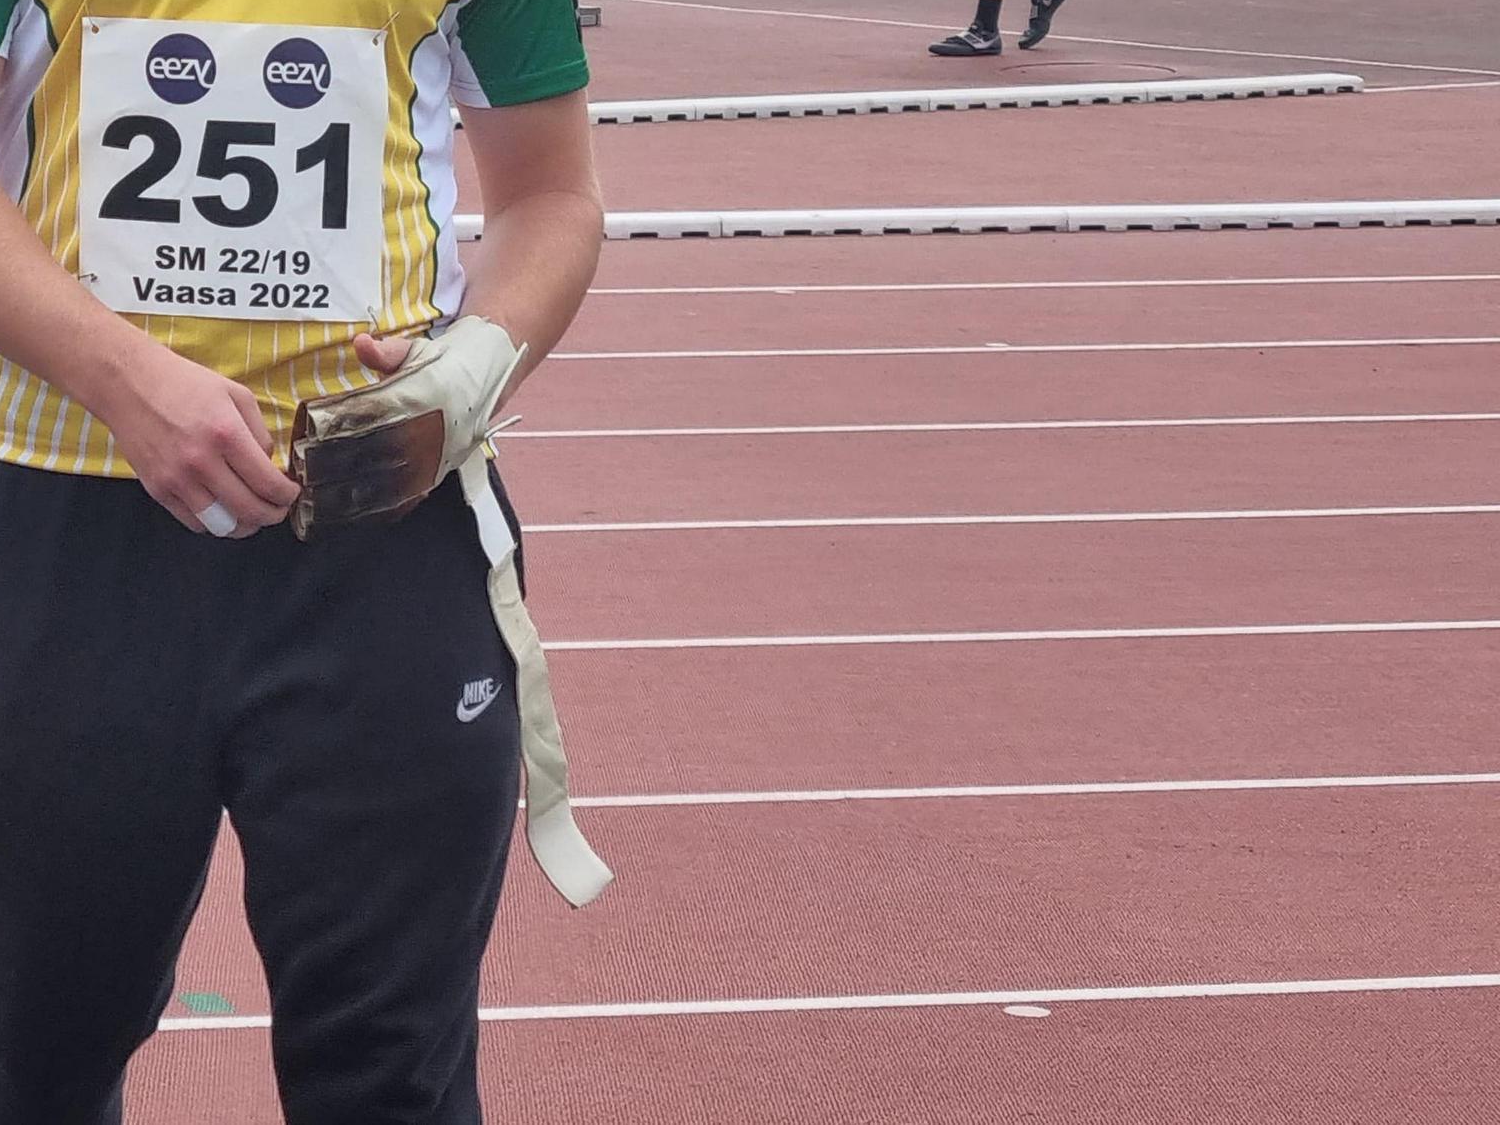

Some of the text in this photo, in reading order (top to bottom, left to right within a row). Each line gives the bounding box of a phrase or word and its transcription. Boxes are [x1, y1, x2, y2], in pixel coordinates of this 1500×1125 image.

[149, 56, 215, 89] eezy
[266, 61, 330, 94] eezy
[98, 114, 351, 230] 251
[155, 245, 311, 276] SM 22/19
[133, 276, 330, 309] Vaasa 2022
[463, 677, 495, 706] NIKE
